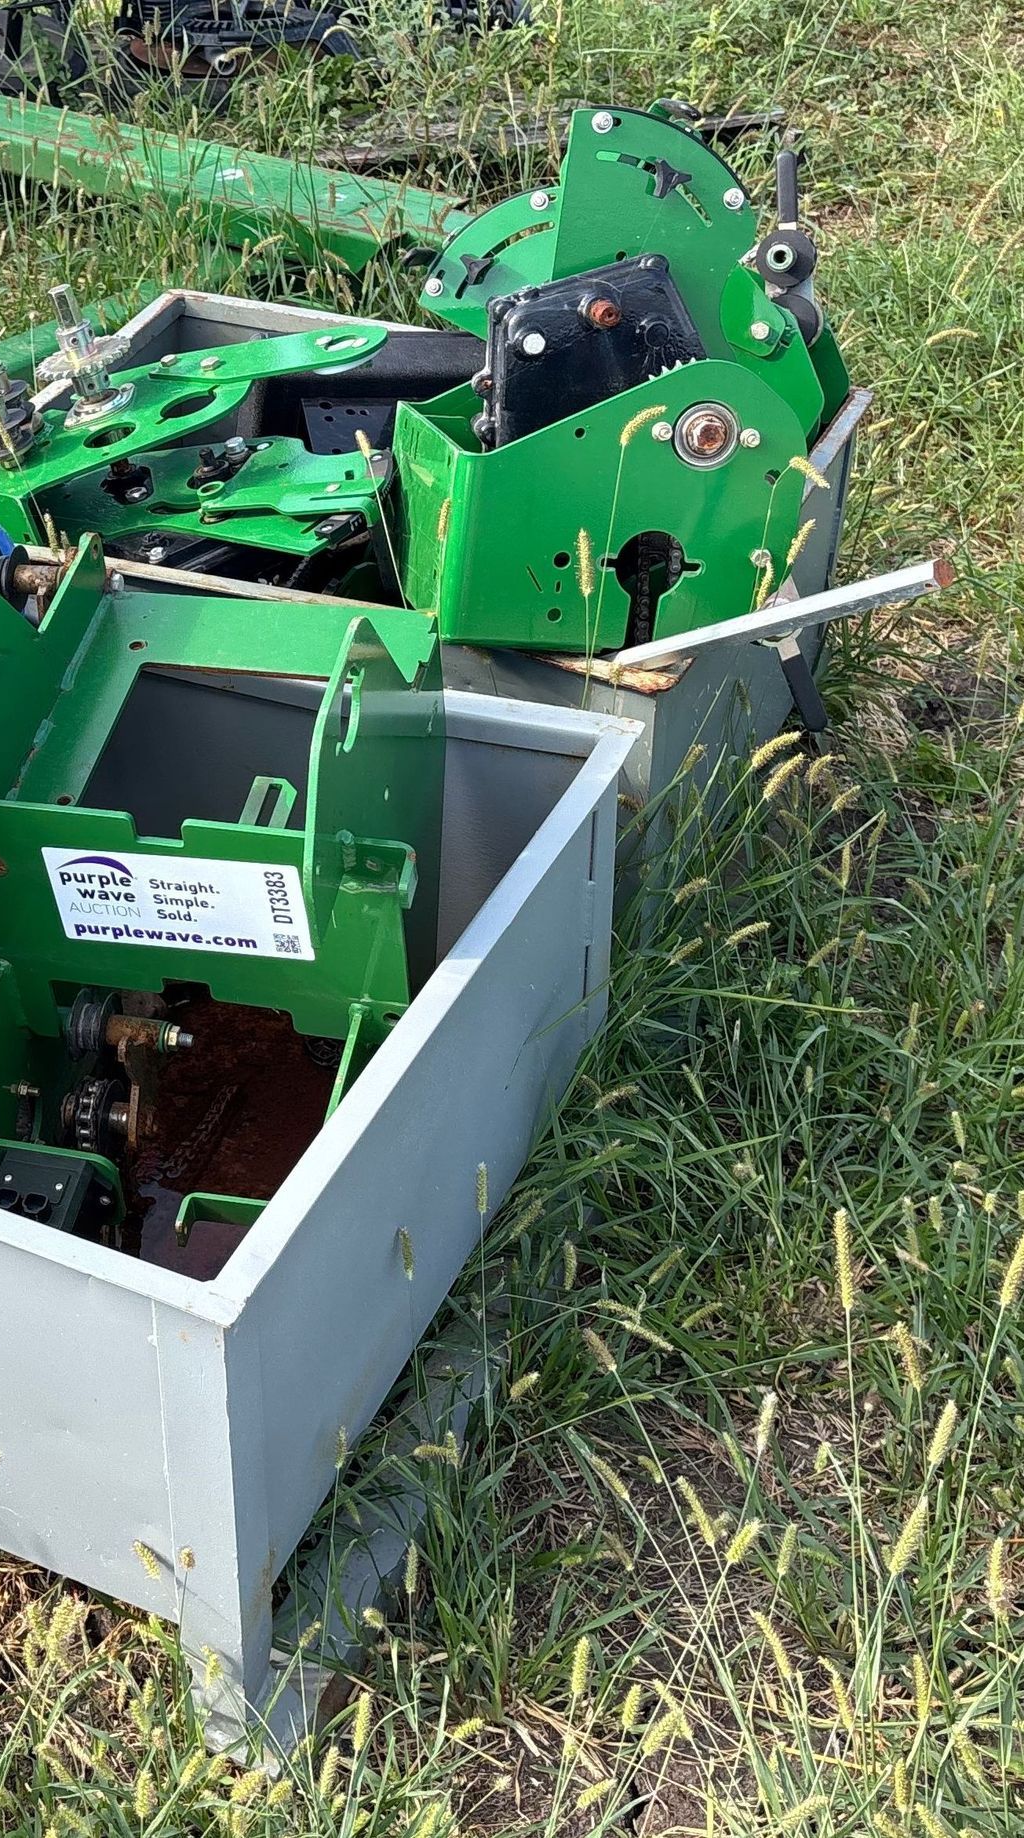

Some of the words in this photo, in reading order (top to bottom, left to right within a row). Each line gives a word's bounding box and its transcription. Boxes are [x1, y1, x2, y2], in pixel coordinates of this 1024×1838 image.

[59, 870, 132, 888] purple
[149, 879, 220, 894] Straight.
[77, 888, 136, 902] wave
[153, 894, 215, 910] Simple.
[264, 871, 293, 925] DT3383
[70, 902, 141, 918] AUCTION
[157, 909, 198, 922] Sold.
[74, 923, 258, 949] purplewave.com
